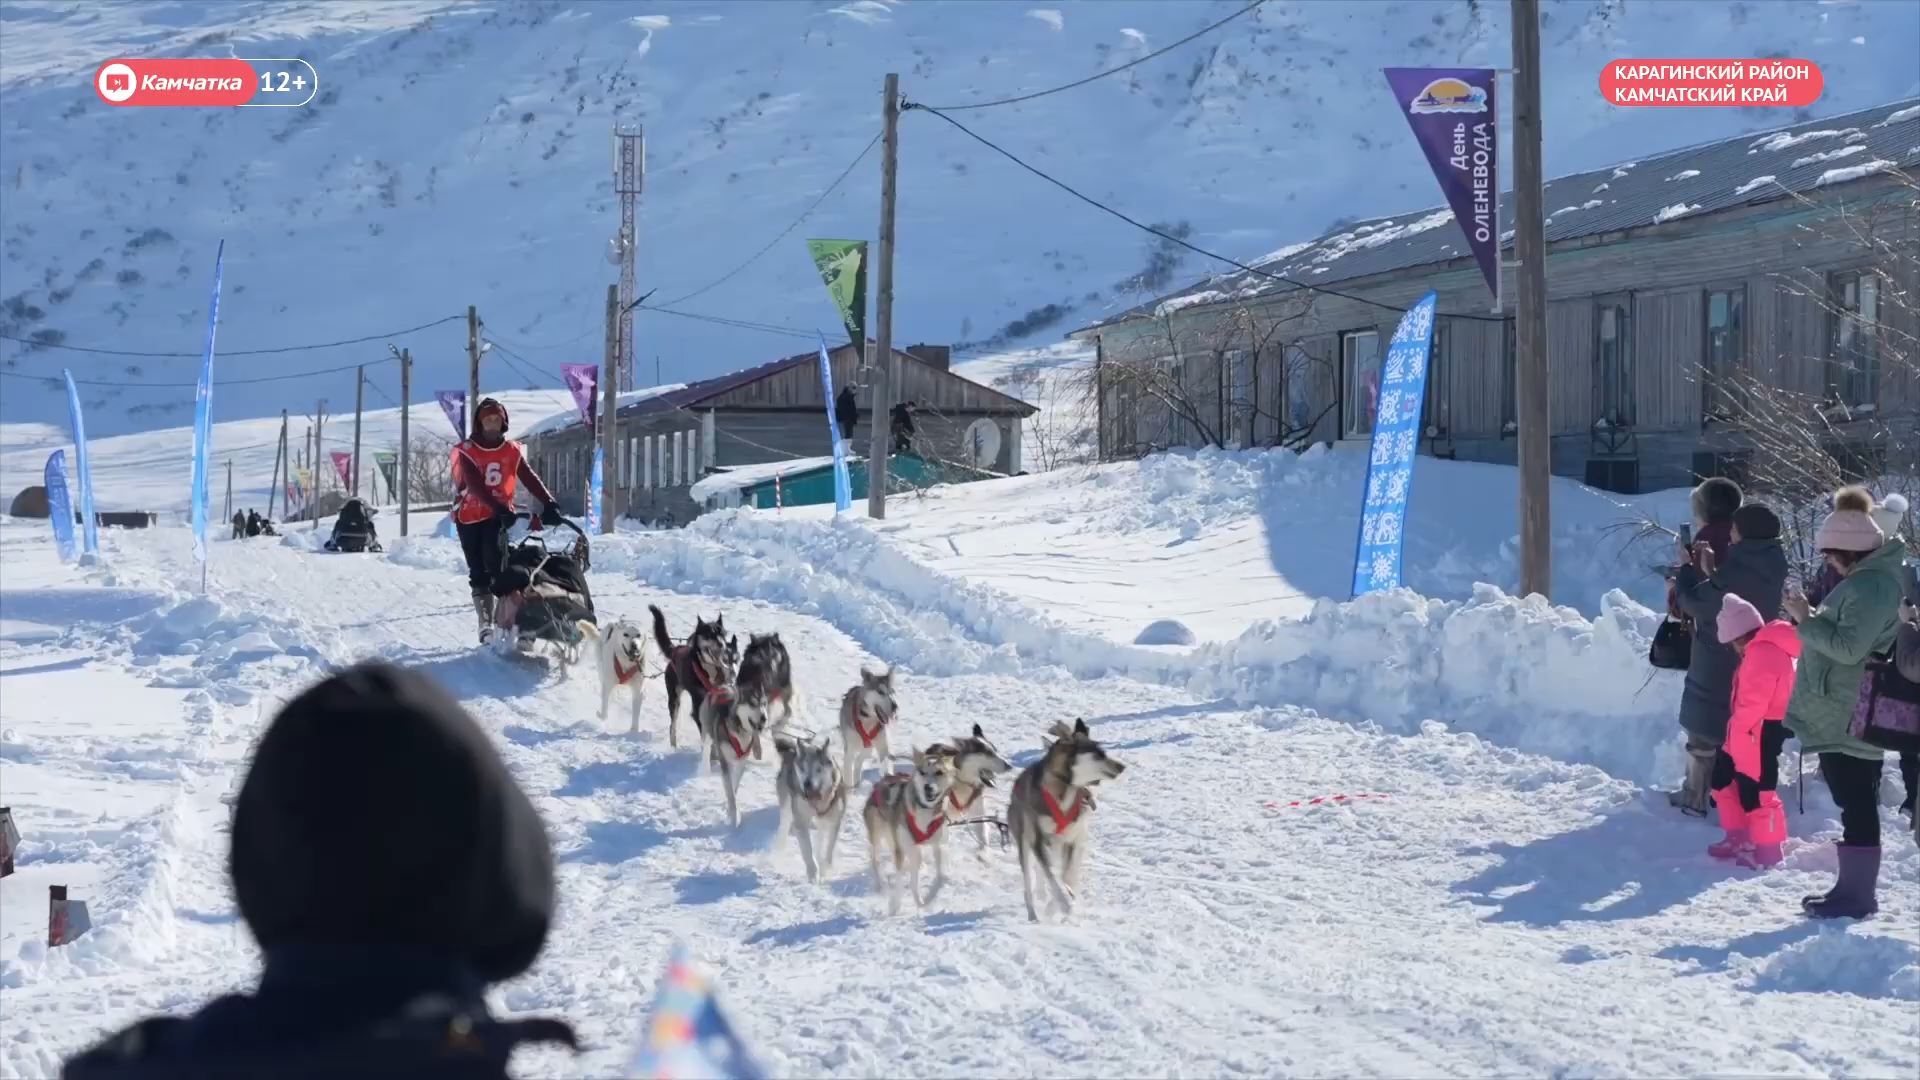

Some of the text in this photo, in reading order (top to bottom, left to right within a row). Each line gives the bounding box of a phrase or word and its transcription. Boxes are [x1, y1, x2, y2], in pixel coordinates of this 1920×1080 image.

[1450, 122, 1469, 170] День
[1473, 122, 1490, 243] ОЛЕНЕВОДА
[484, 462, 502, 486] 6
